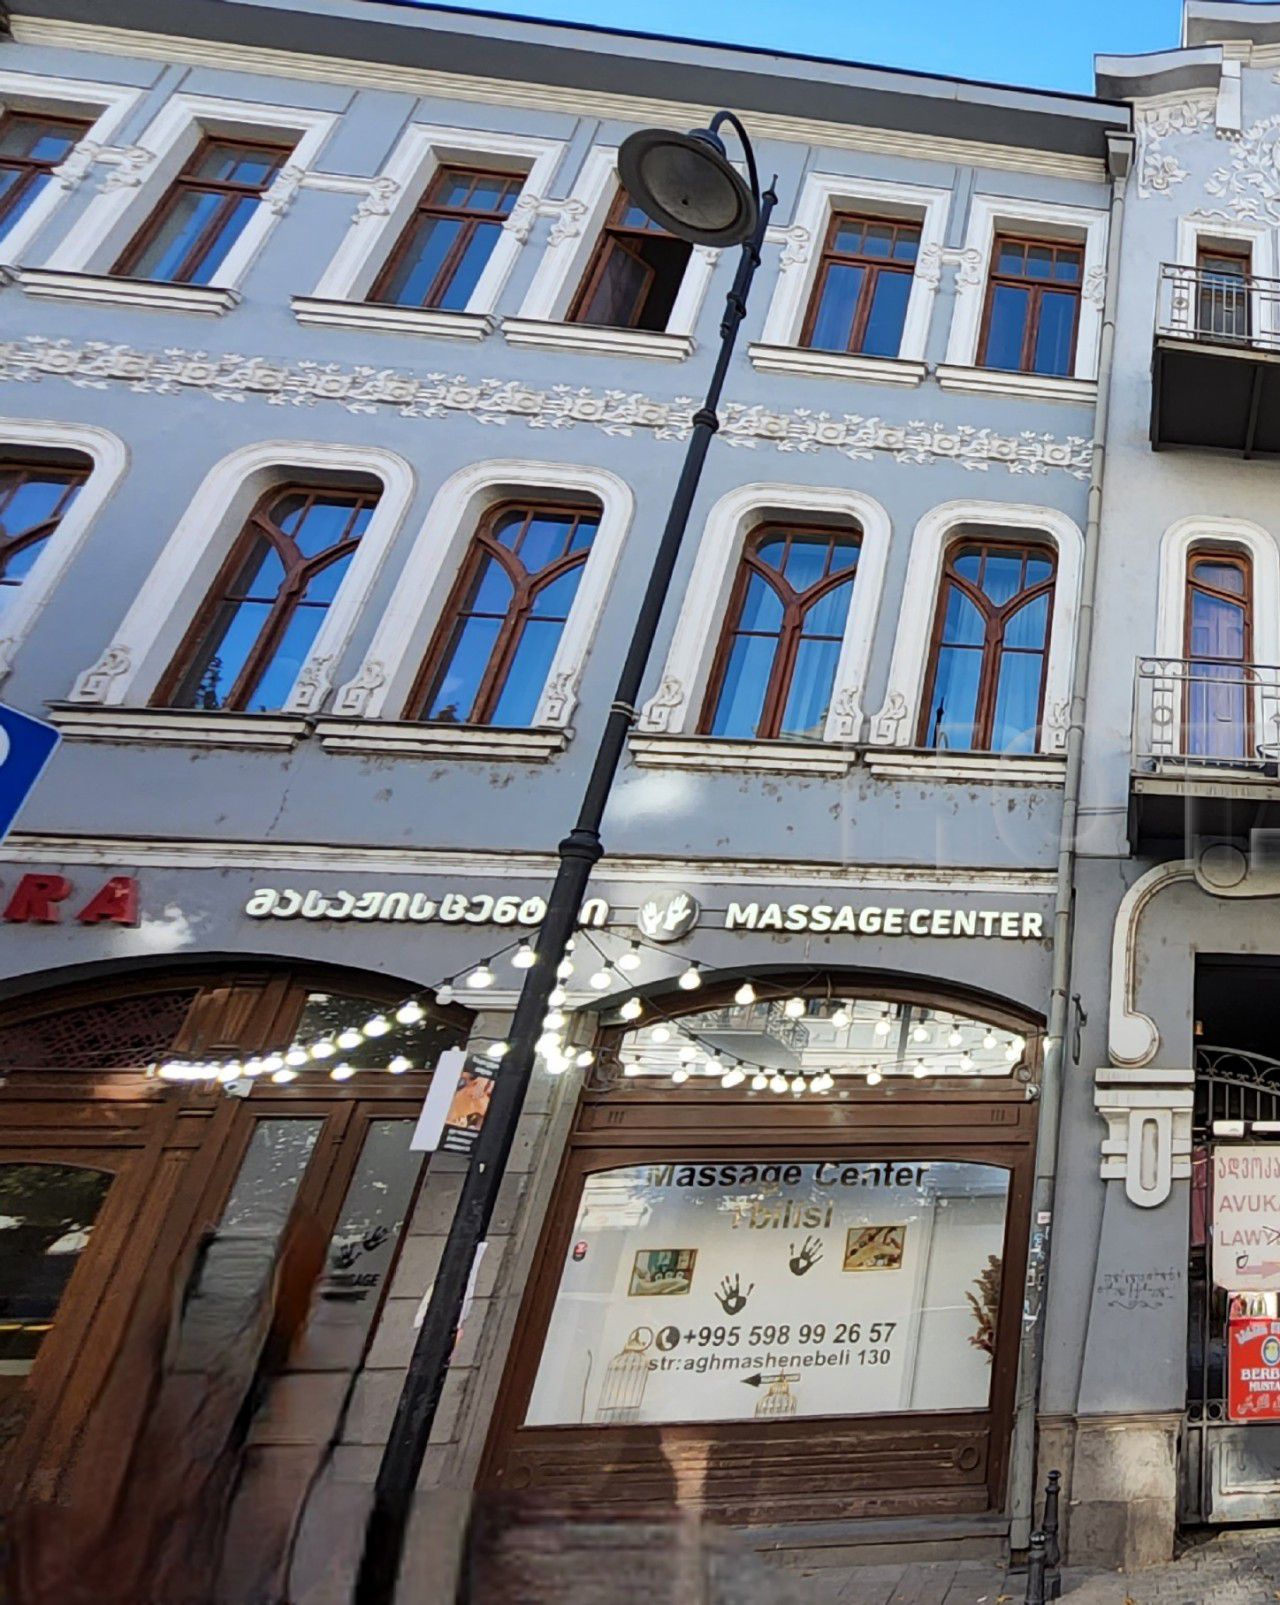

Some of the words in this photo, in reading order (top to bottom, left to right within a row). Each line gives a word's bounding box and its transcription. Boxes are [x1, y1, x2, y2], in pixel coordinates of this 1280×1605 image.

[0, 873, 140, 926] RA
[439, 893, 610, 927] ცენტი
[724, 902, 904, 934] MASSAGE
[908, 908, 1043, 938] CENTER
[648, 1163, 802, 1188] Massage
[815, 1161, 930, 1188] Center
[684, 1325, 742, 1347] +995
[749, 1325, 791, 1346] 598
[798, 1324, 826, 1344] 99
[833, 1323, 861, 1343] 26
[869, 1322, 897, 1343] 57
[857, 1349, 891, 1366] 130
